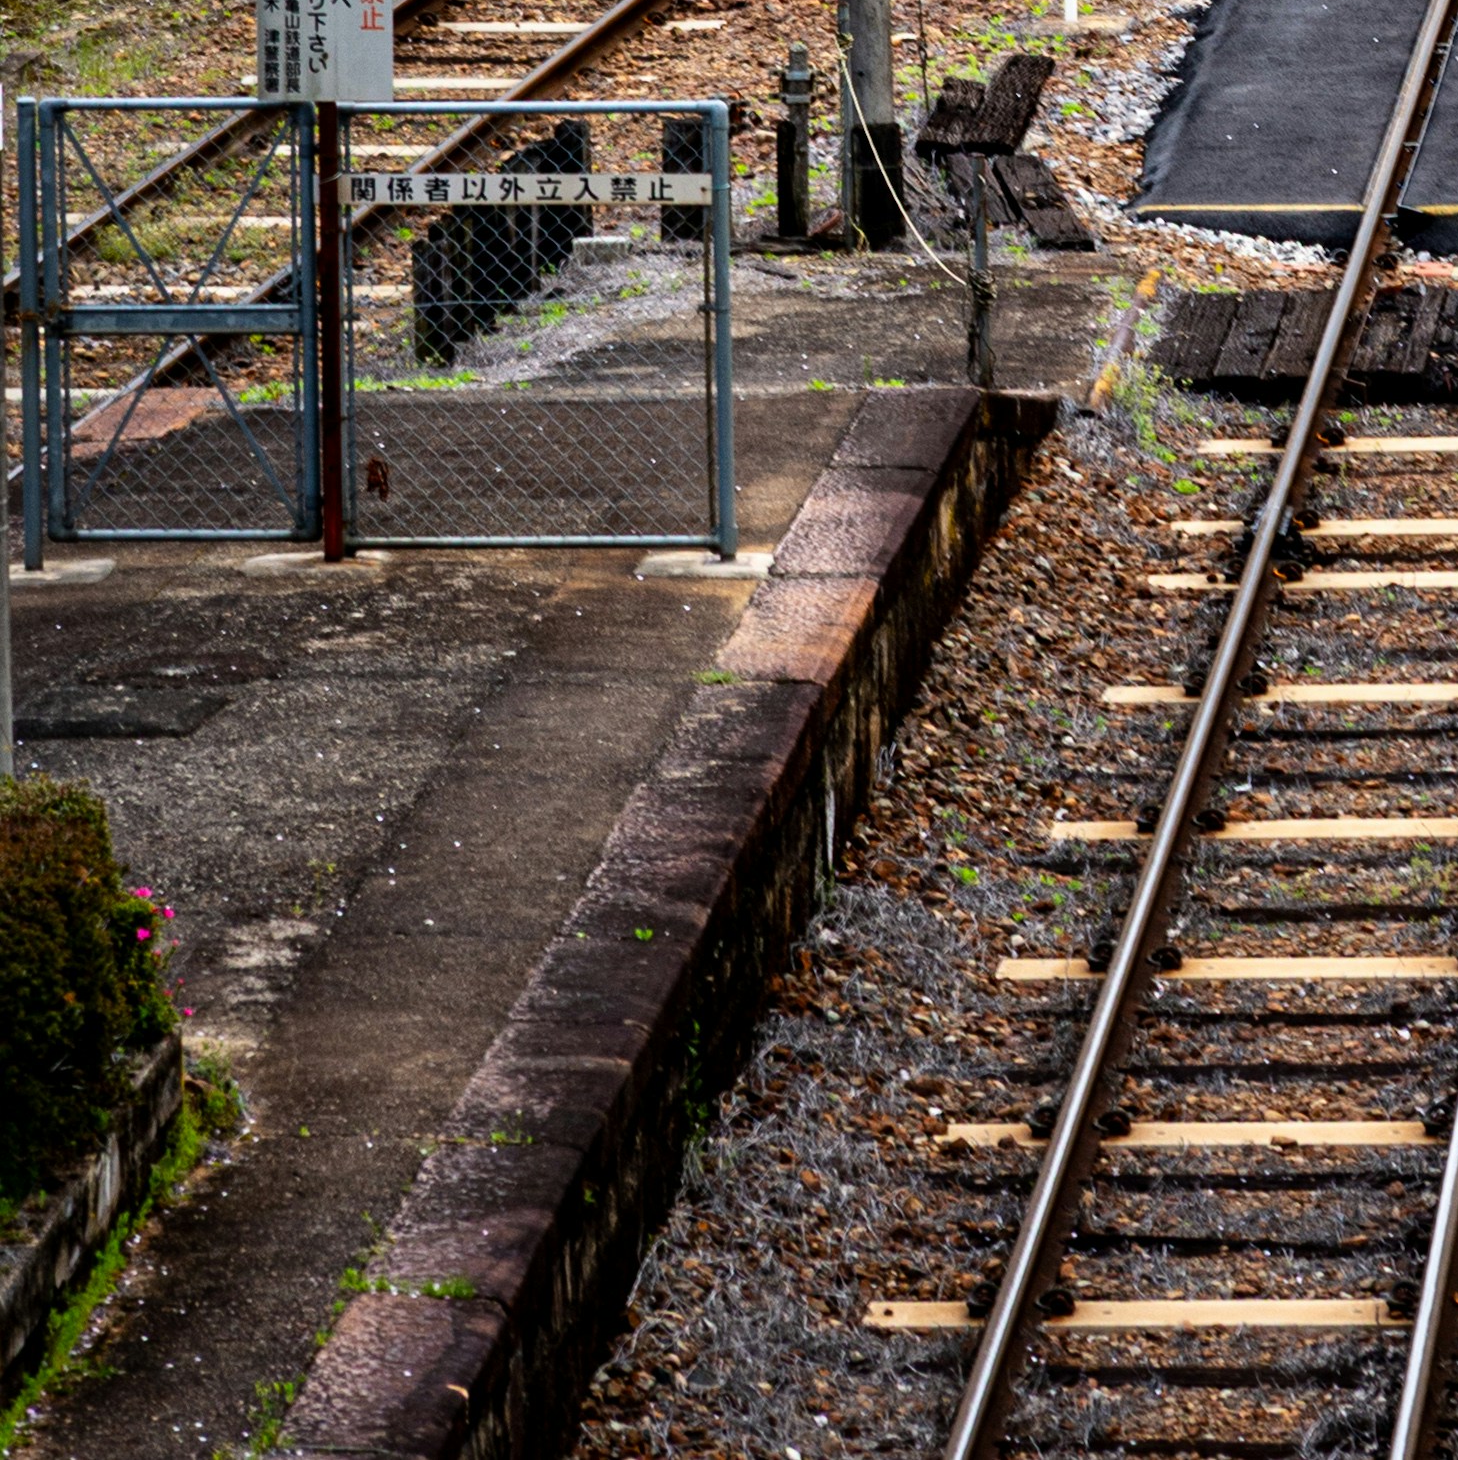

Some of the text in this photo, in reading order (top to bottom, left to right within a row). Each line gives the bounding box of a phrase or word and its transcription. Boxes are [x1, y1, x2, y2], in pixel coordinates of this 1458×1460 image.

[350, 177, 675, 203] 関係者以外立入禁止
